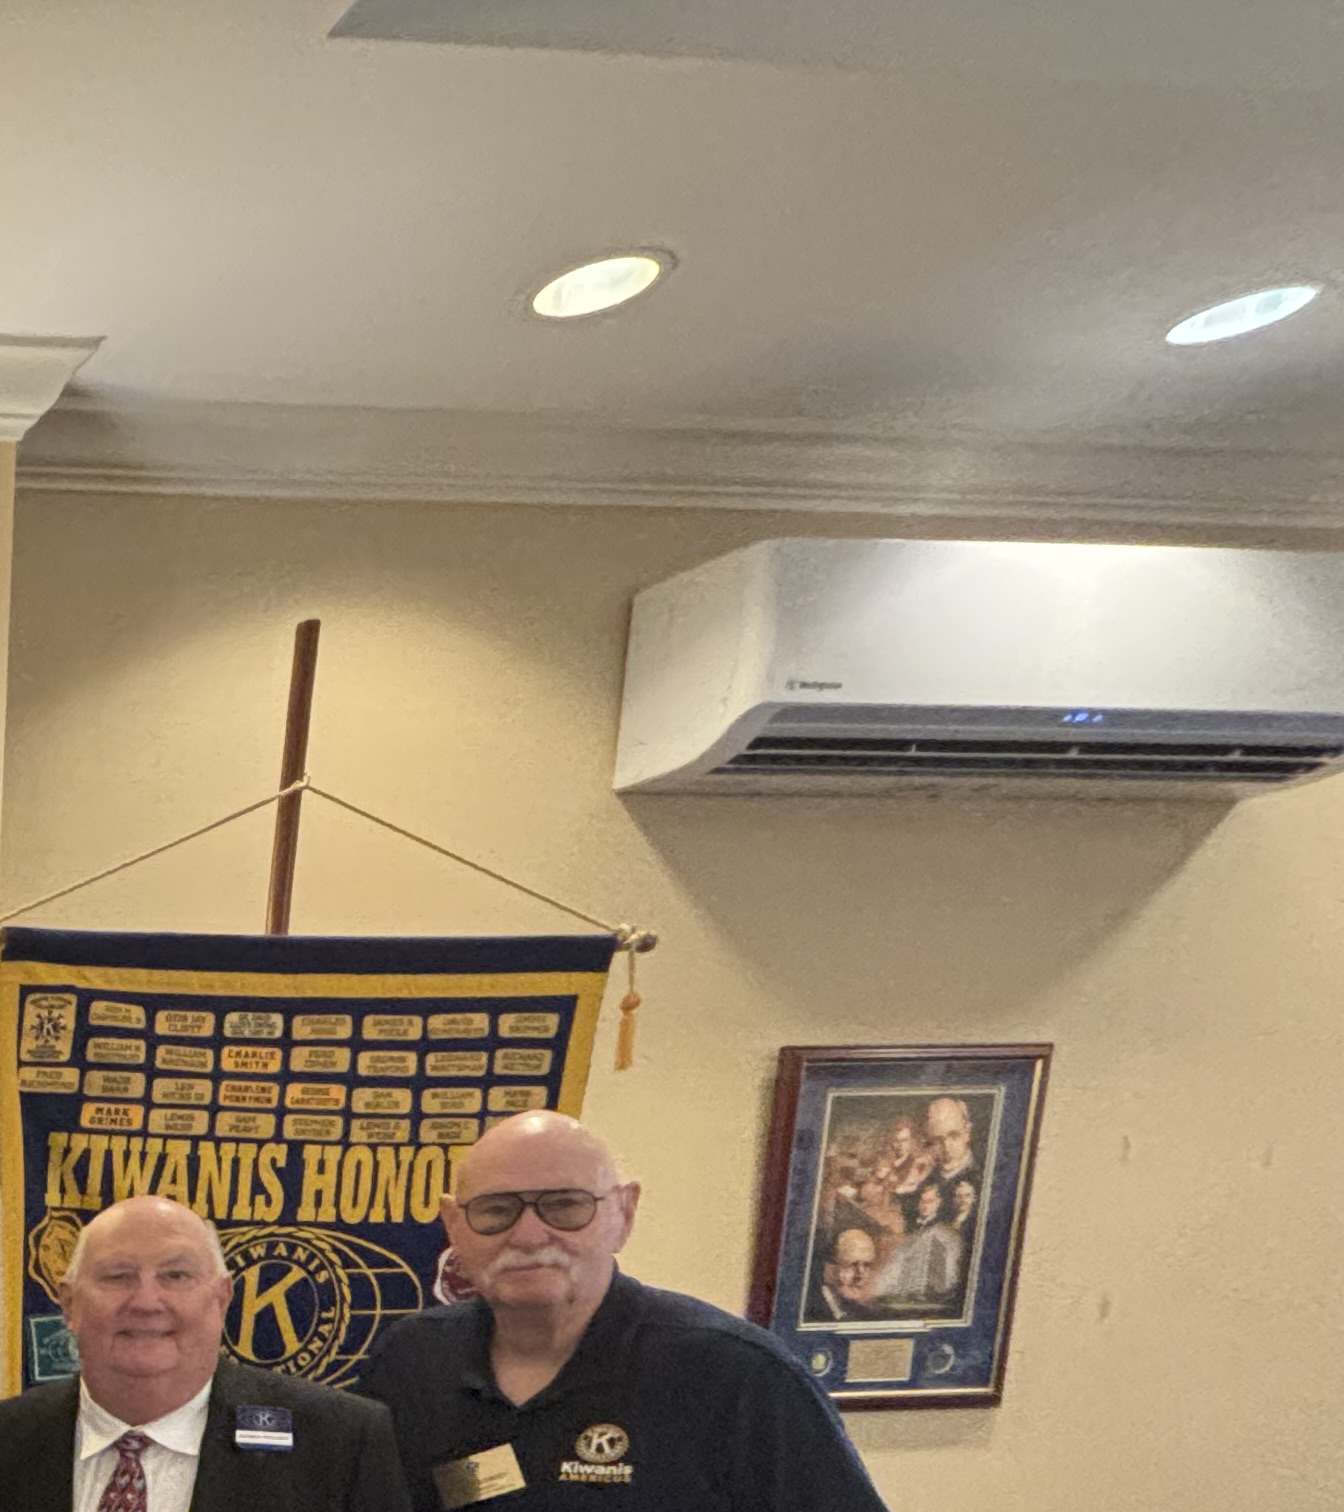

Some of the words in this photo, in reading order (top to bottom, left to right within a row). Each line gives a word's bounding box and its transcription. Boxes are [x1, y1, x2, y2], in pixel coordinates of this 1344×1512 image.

[227, 1048, 277, 1060] CHARLIE
[233, 1059, 270, 1070] SMITH
[94, 1106, 131, 1116] MARK
[88, 1116, 134, 1127] GRIMES
[45, 1131, 288, 1223] KIWANIS
[296, 1144, 470, 1225] HONO
[229, 1242, 330, 1284] IWANIS
[236, 1260, 308, 1363] K
[589, 1432, 613, 1454] K
[560, 1460, 634, 1476] Kiwanis
